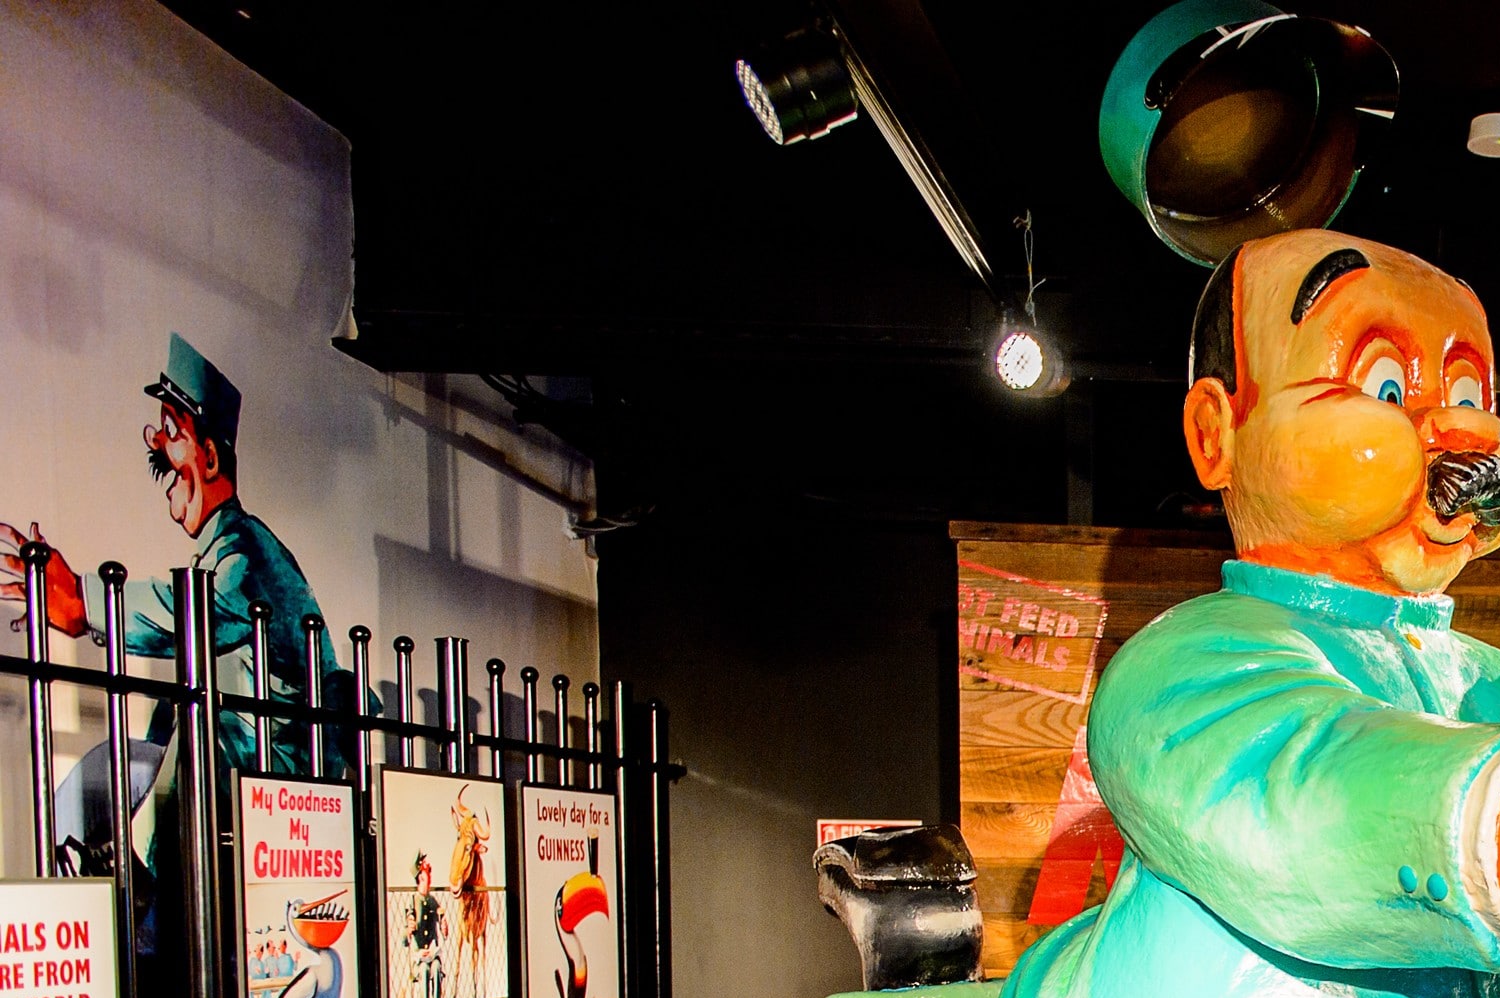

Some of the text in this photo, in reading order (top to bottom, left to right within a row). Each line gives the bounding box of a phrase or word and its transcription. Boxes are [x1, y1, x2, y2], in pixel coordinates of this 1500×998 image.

[1000, 597, 1080, 638] FEED
[252, 786, 341, 816] My Goodness
[537, 798, 609, 828] Lovely day for a
[290, 817, 309, 847] My
[253, 841, 343, 879] GUINNESS
[537, 834, 585, 861] GUINNESS
[56, 921, 90, 951] ON
[33, 958, 91, 988] FROM
